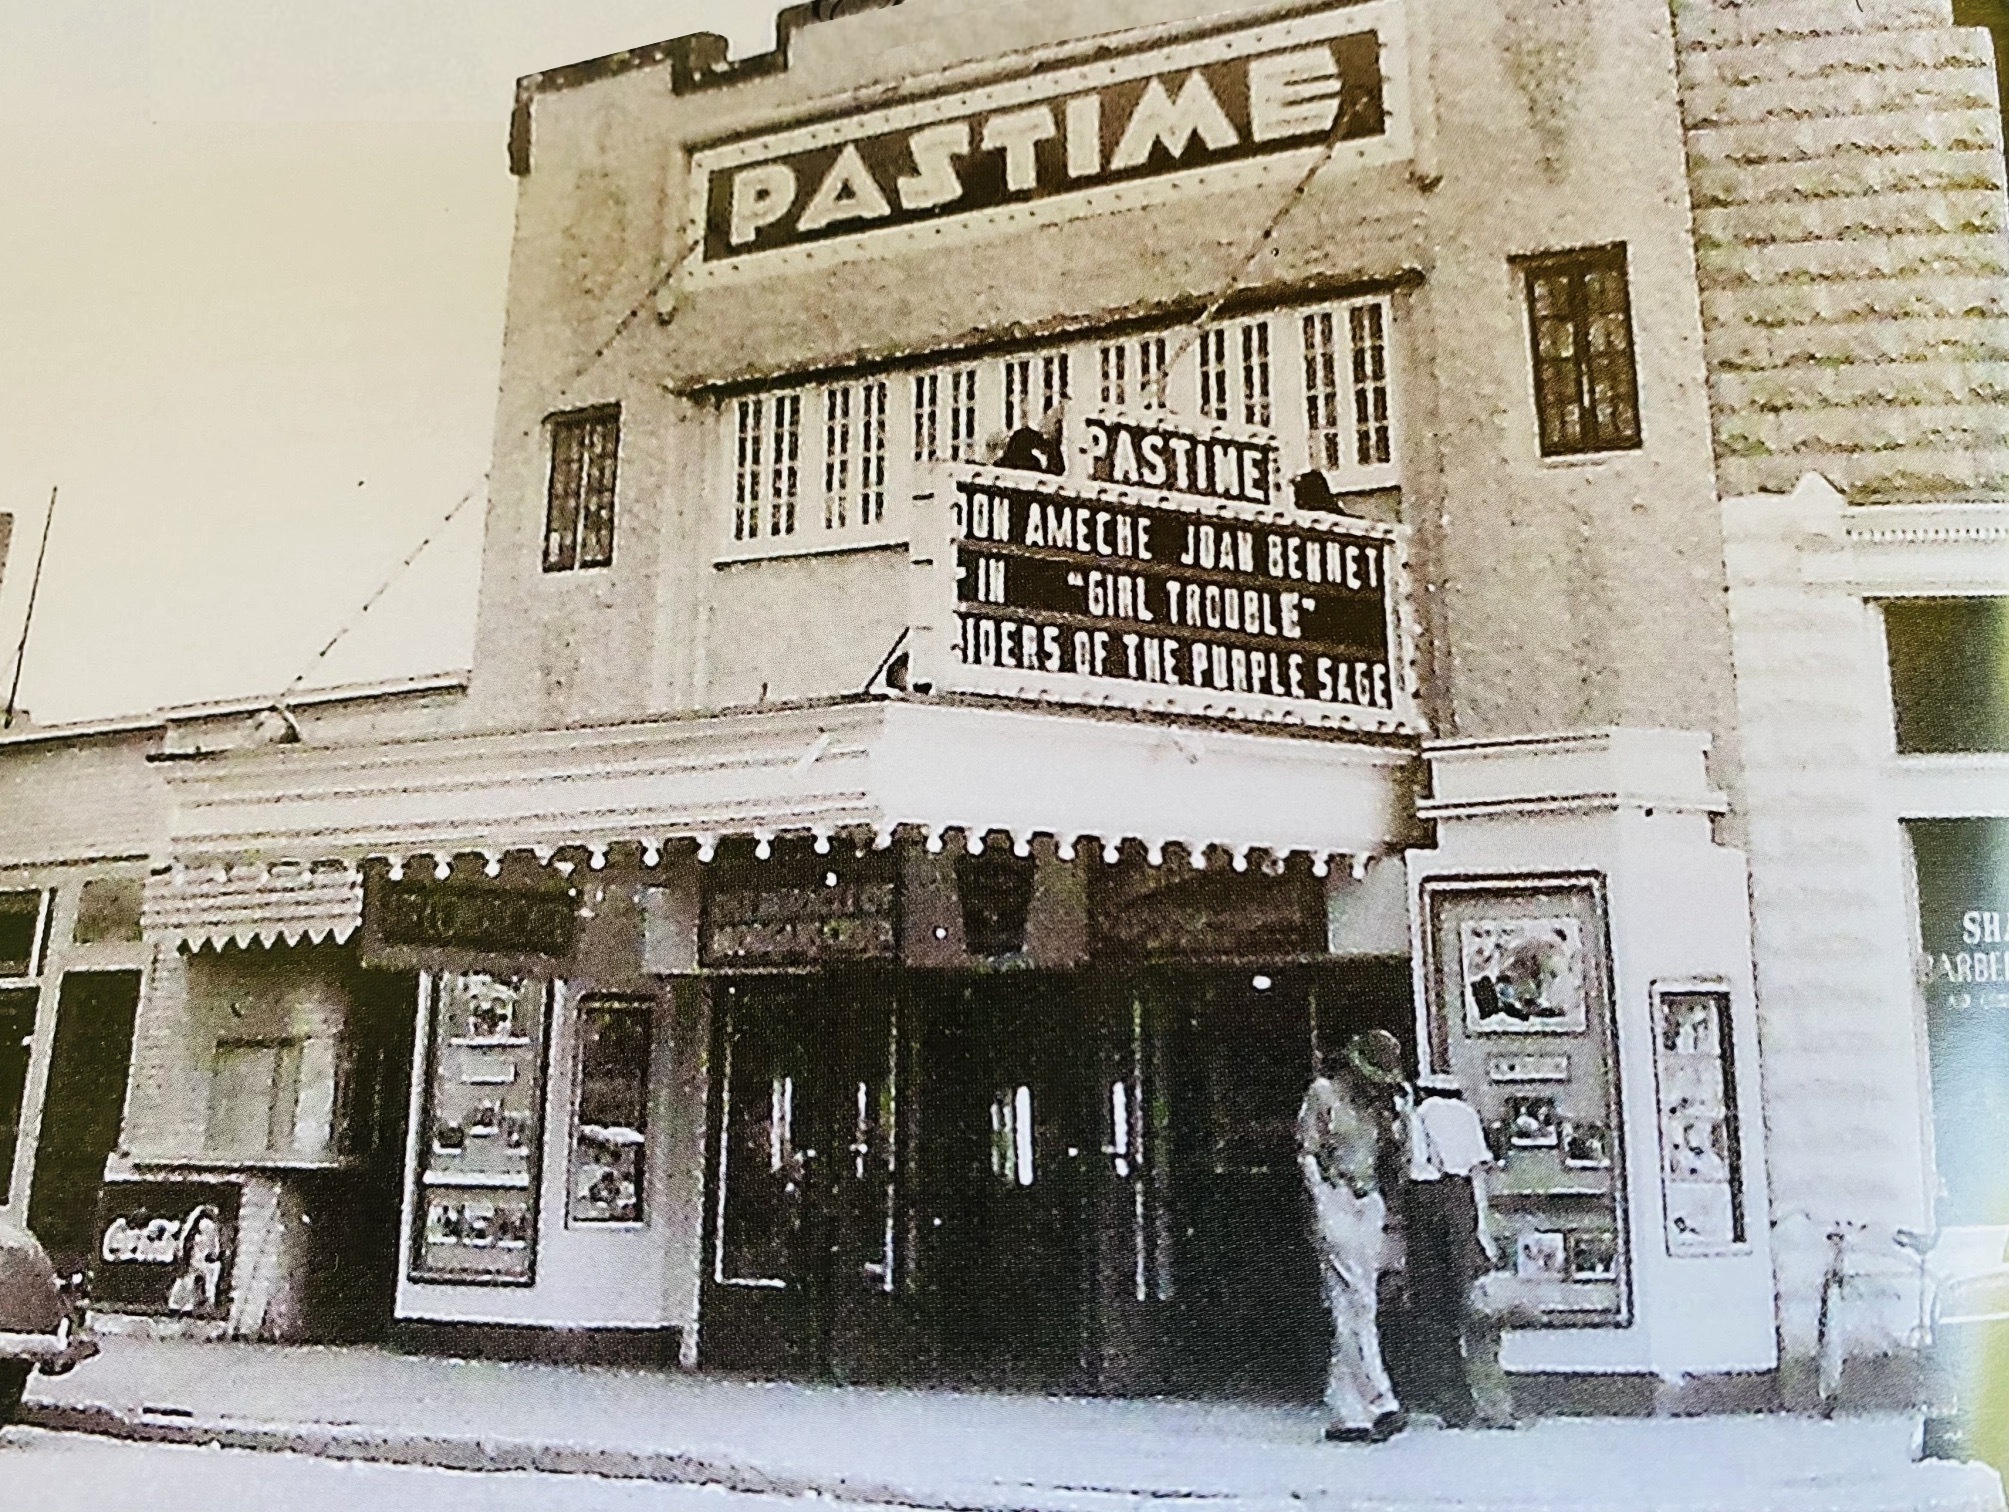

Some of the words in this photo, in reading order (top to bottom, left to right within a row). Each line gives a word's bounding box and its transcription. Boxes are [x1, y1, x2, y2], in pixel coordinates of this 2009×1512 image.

[731, 44, 1343, 245] PASTIME
[1088, 426, 1265, 501] PASTIME
[977, 557, 1005, 604] IN
[1025, 502, 1152, 560] AMECHE
[1181, 525, 1254, 573] JOAN
[1268, 534, 1378, 590] BENNET
[1074, 631, 1109, 676] OF
[1122, 633, 1180, 684] THE
[1191, 642, 1305, 699] PURPLE
[1317, 656, 1388, 708] SAGE
